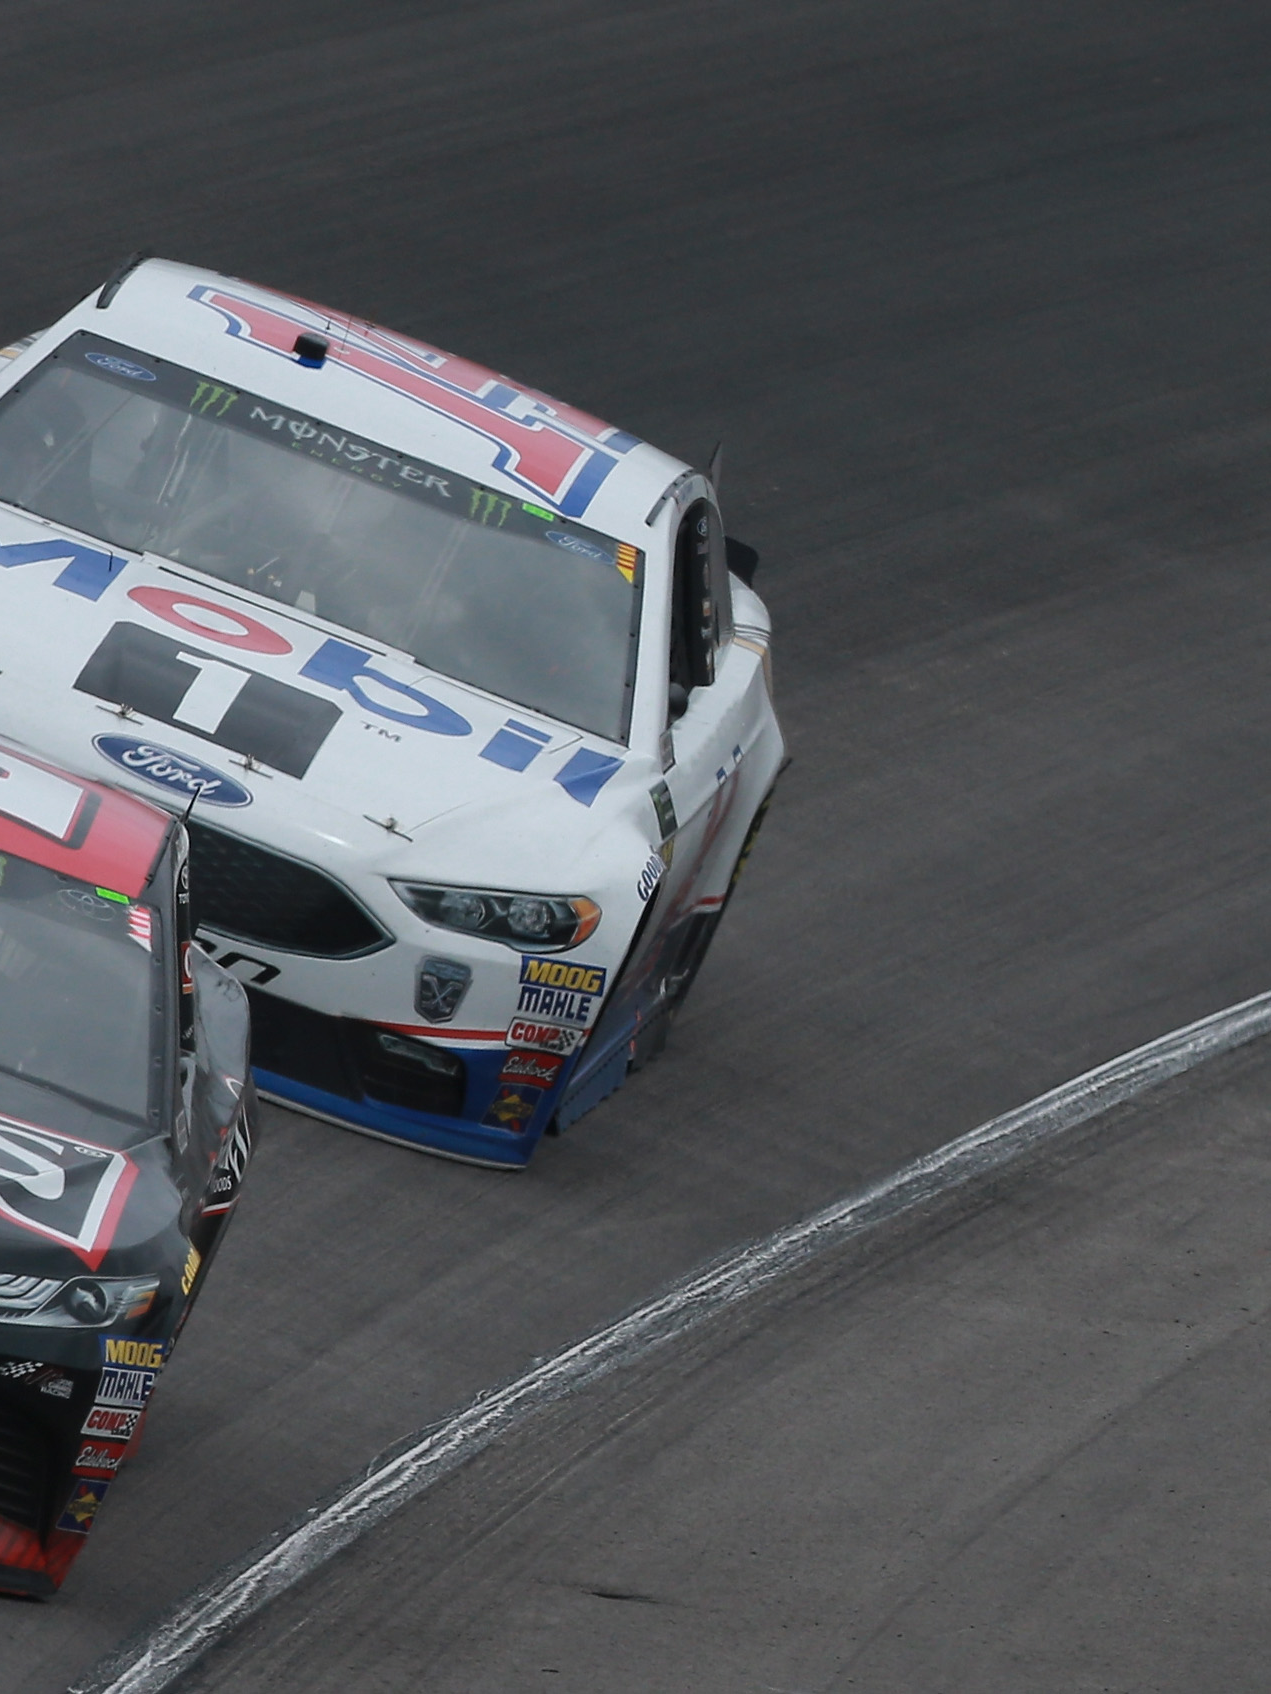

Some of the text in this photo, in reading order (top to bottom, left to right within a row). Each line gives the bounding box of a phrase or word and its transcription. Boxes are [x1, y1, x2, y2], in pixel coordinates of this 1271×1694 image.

[96, 356, 143, 377] Ford
[172, 650, 252, 735] 1
[121, 744, 223, 797] Ford
[524, 959, 604, 993] MOOG
[517, 985, 593, 1023] MAHLE
[510, 1022, 561, 1044] COMP
[105, 1338, 164, 1369] MOOG
[97, 1370, 155, 1402] MAHLE
[86, 1409, 127, 1431] COMP
